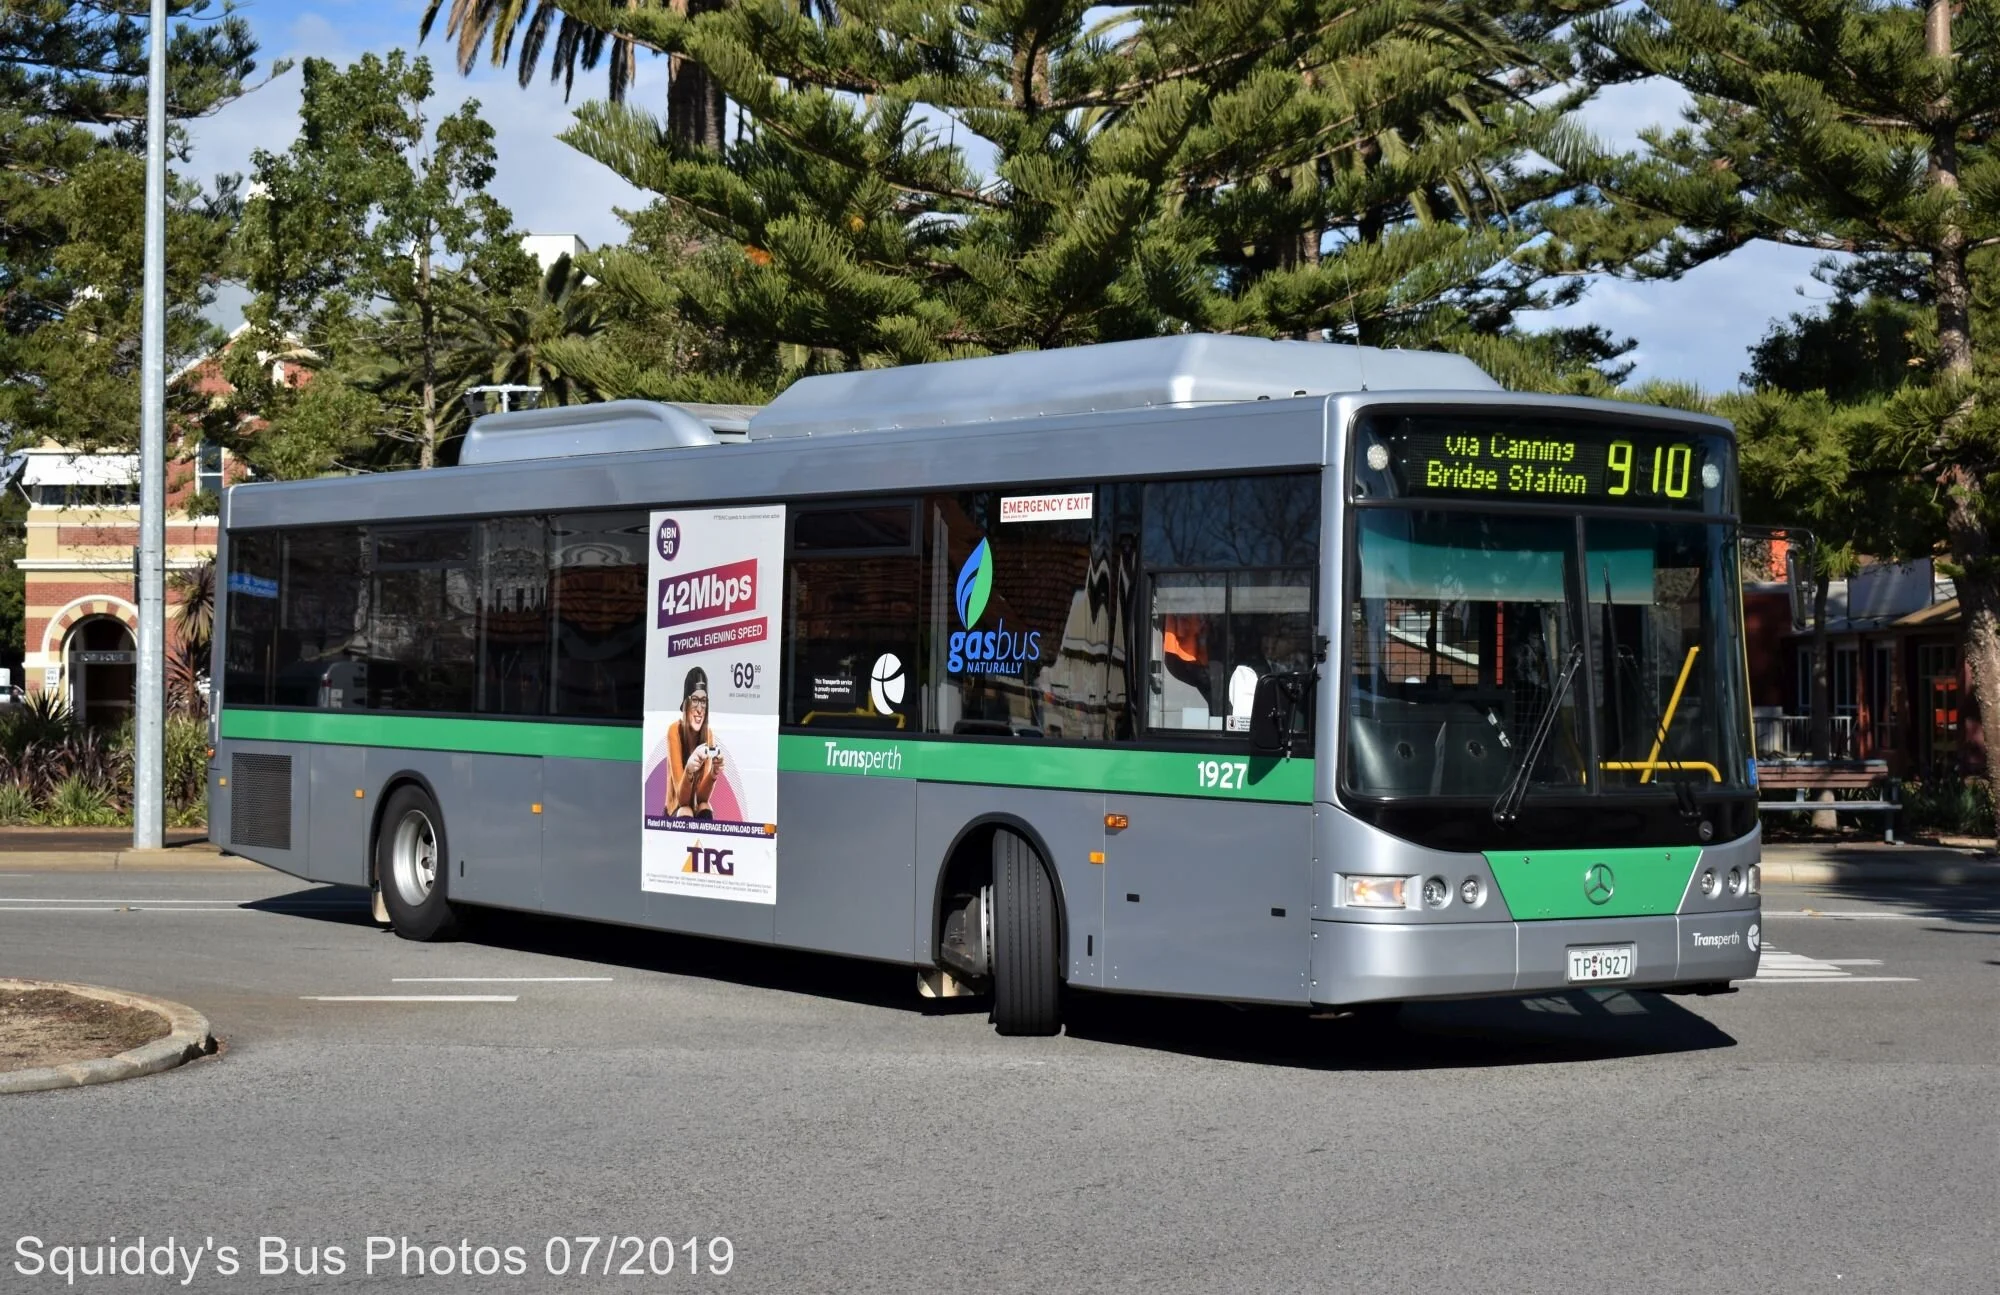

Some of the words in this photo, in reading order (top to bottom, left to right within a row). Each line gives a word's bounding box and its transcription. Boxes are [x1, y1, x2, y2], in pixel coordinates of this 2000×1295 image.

[1445, 435, 1480, 456] via
[1490, 434, 1575, 462] Canning
[1426, 460, 1498, 490] Bridge
[1508, 465, 1587, 495] Station
[1607, 440, 1691, 498] 910
[1003, 498, 1063, 514] EMERGENCY
[1067, 497, 1090, 511] EXIT
[661, 527, 677, 539] NBN
[663, 540, 674, 554] 50
[662, 574, 752, 616] 42Mbps
[672, 635, 703, 652] TYPICAL
[704, 629, 737, 646] EVENING
[737, 624, 763, 639] SPEED
[966, 661, 1022, 674] NATURALLY
[825, 741, 902, 775] Transperth
[1197, 761, 1247, 790] 1927
[647, 818, 660, 827] Rated
[666, 821, 672, 829] by
[700, 823, 722, 832] AVERAGE
[722, 824, 750, 834] DOWNLOAD
[686, 846, 734, 876] TPG
[1693, 931, 1740, 949] Transperth
